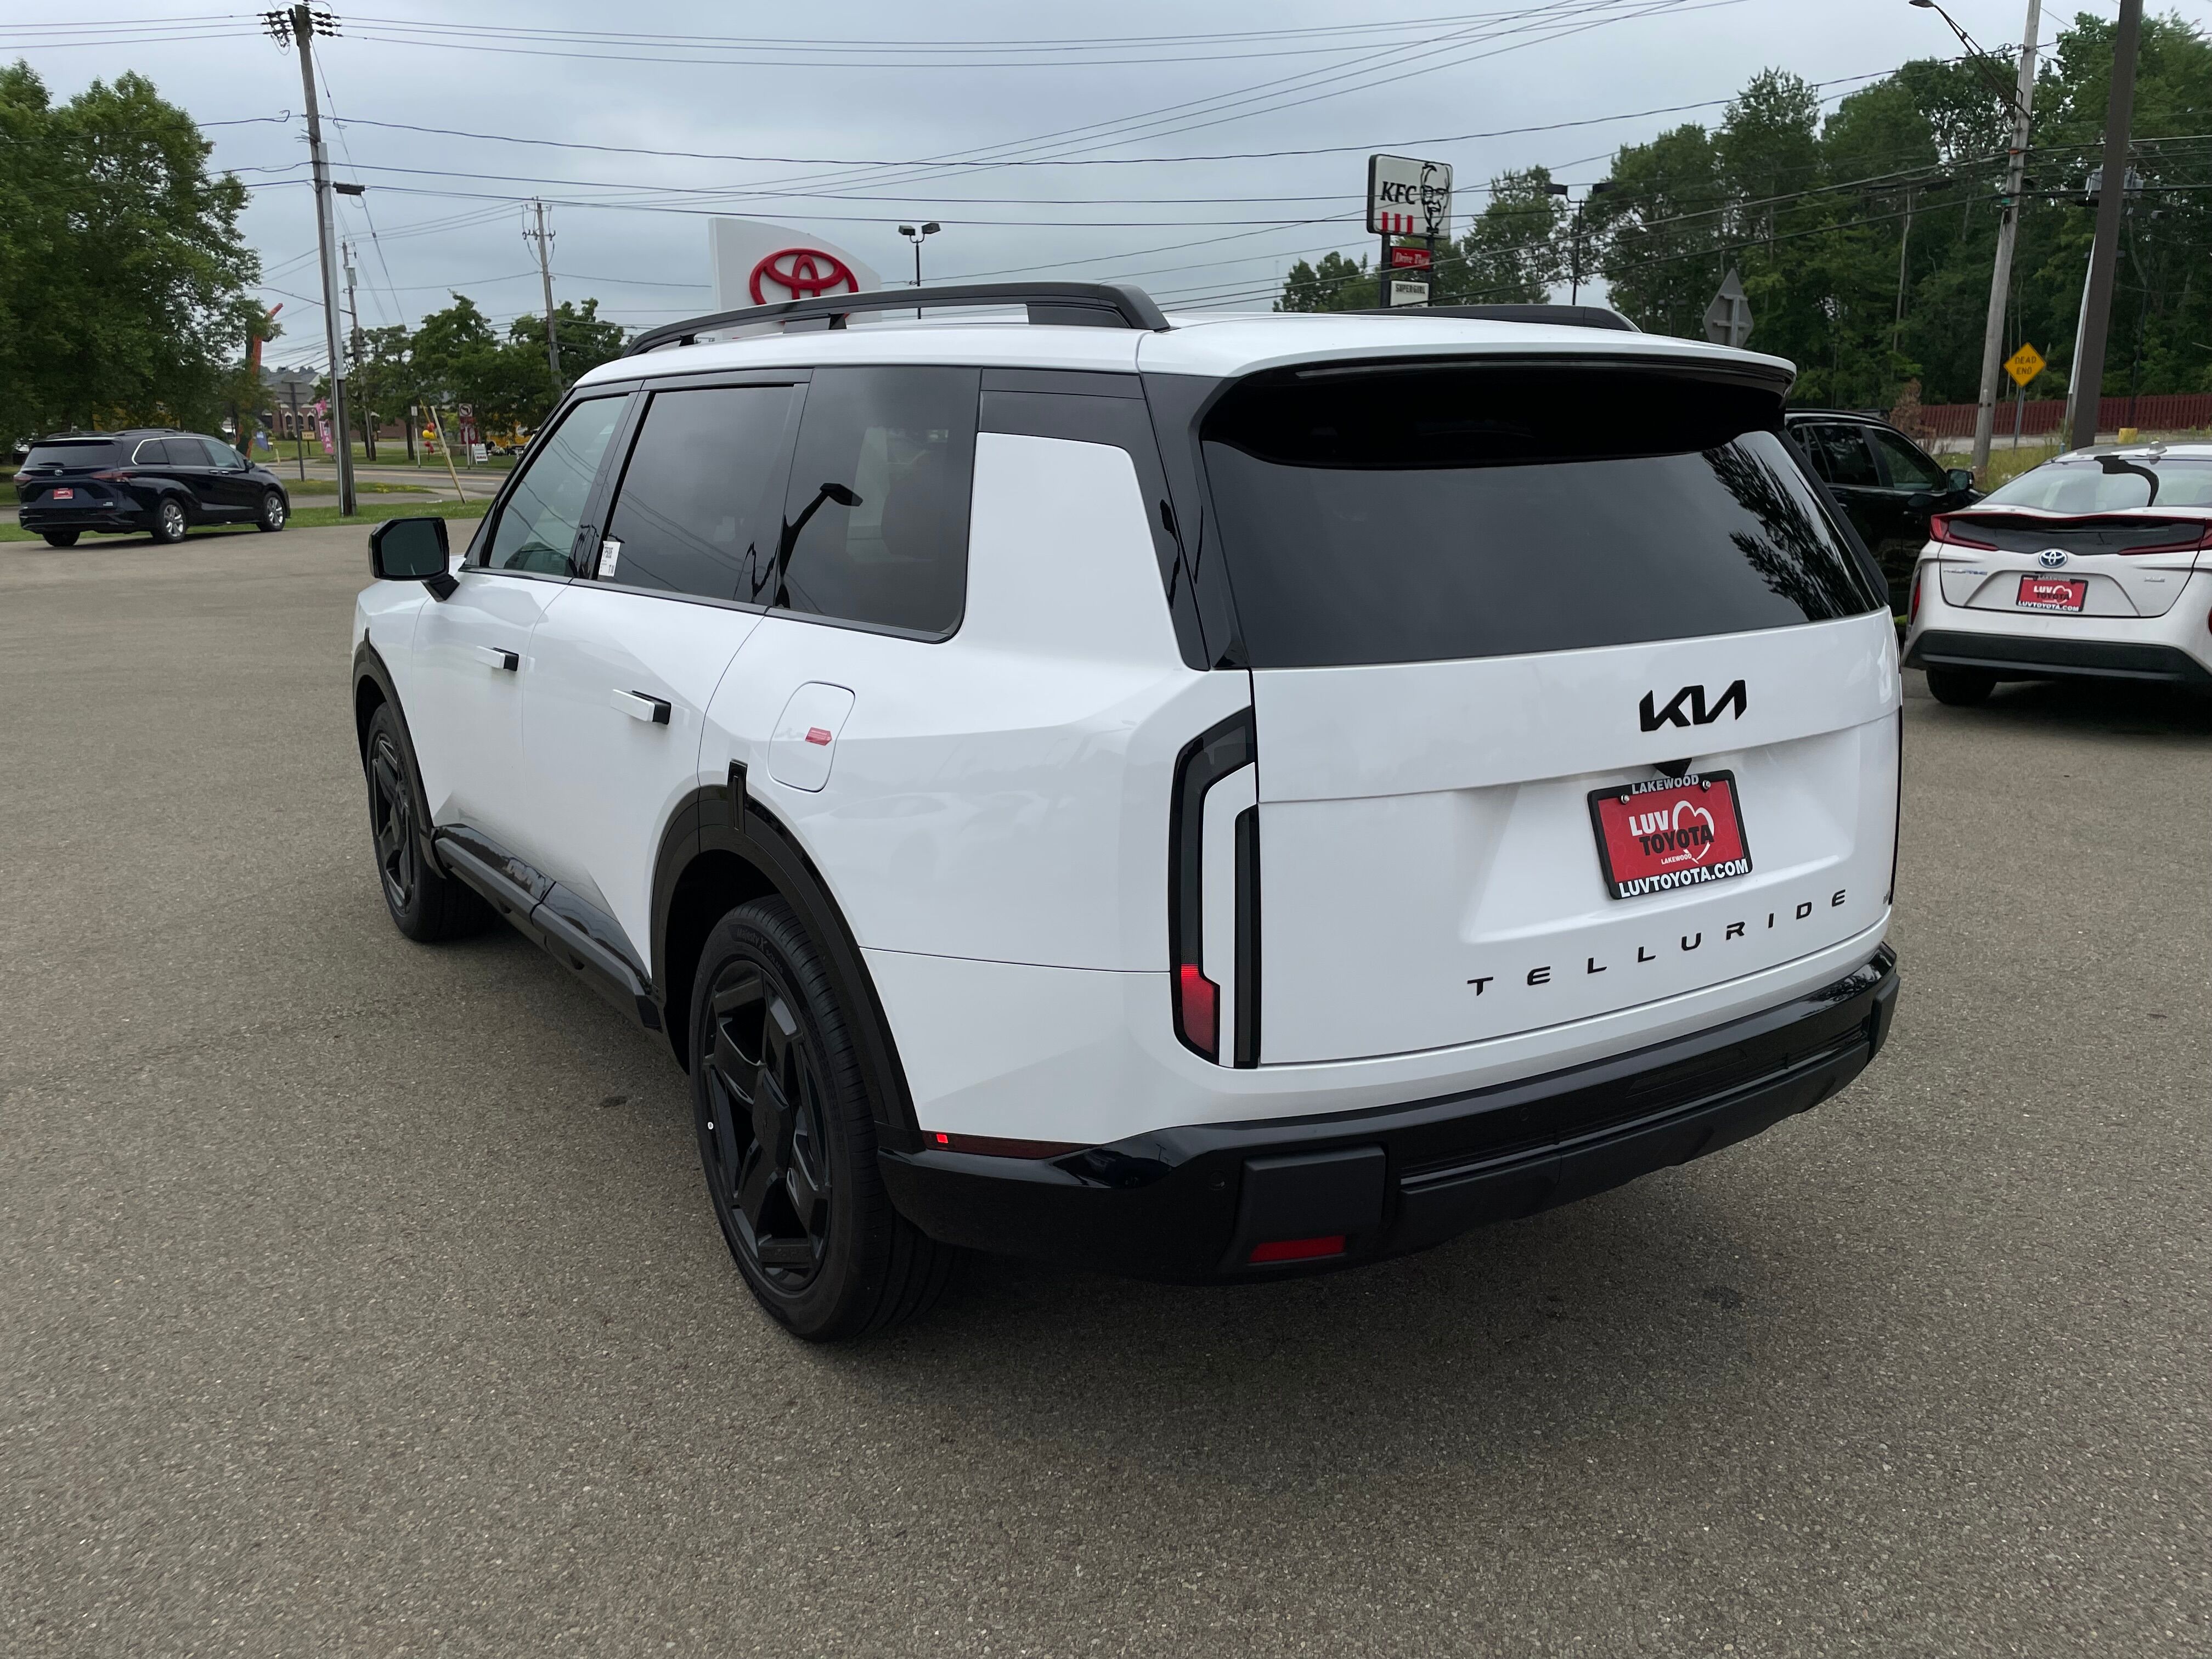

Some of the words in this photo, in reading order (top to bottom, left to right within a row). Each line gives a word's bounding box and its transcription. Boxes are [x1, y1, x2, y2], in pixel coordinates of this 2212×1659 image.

[1380, 180, 1417, 205] KFC
[2015, 356, 2036, 364] DEAD
[2018, 601, 2079, 612] LUVTOYOTA.COM
[1639, 680, 1747, 732] KIA
[1632, 775, 1700, 794] LAKEWOOD
[1629, 810, 1668, 836] LUV
[1639, 825, 1714, 856] TOYOTA
[1661, 853, 1692, 865] LAKEWOOD
[1618, 859, 1748, 898] LUVTOYOTA.COM
[1467, 889, 1846, 996] TELLURIDE
